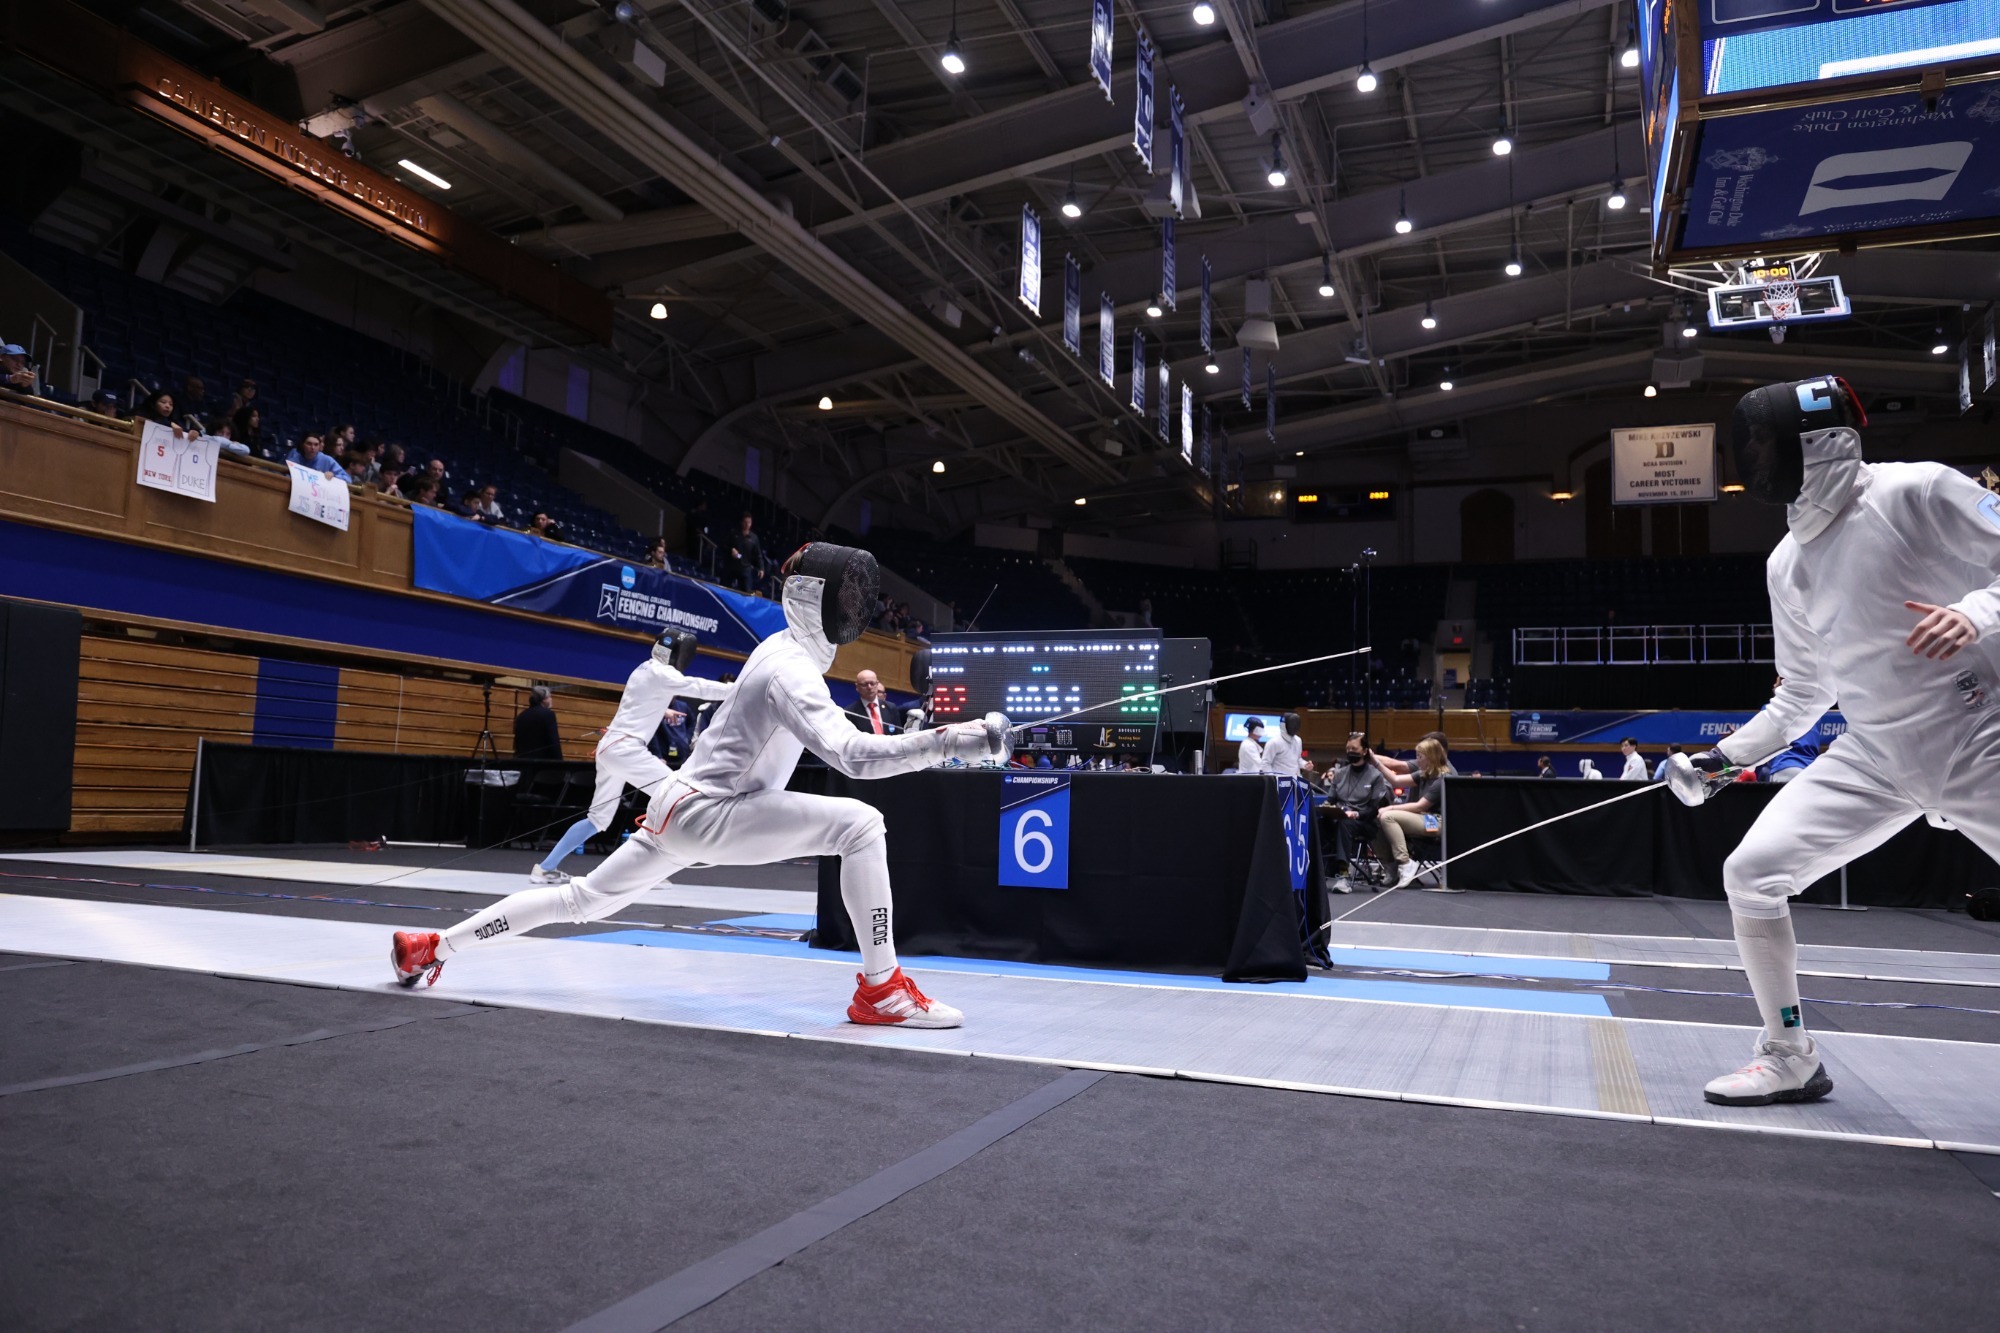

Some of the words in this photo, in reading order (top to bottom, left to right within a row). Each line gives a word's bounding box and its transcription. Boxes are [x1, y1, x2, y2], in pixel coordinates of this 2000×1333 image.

[1805, 110, 1848, 121] Club
[1855, 107, 1895, 119] Golf
[1847, 110, 1955, 129] Washington
[1793, 122, 1840, 133] Duke
[156, 78, 266, 146] CAMERON
[275, 137, 349, 190] INDOOR
[353, 181, 431, 232] STADIUM
[1753, 267, 1789, 279] 10:00
[157, 445, 165, 457] 5
[144, 469, 157, 478] NEW
[1654, 470, 1676, 478] MOST
[181, 474, 205, 490] DUKE
[1629, 480, 1659, 488] CAREER
[1661, 478, 1701, 486] VICTORIES
[618, 597, 656, 619] FENCING
[656, 605, 719, 633] CHAMPIONSHIPS
[1012, 776, 1059, 785] CHAMPIONSHIPS
[1014, 809, 1054, 874] 6
[1297, 814, 1307, 876] 5
[474, 914, 510, 941] FENCING
[870, 907, 888, 946] FENCING
